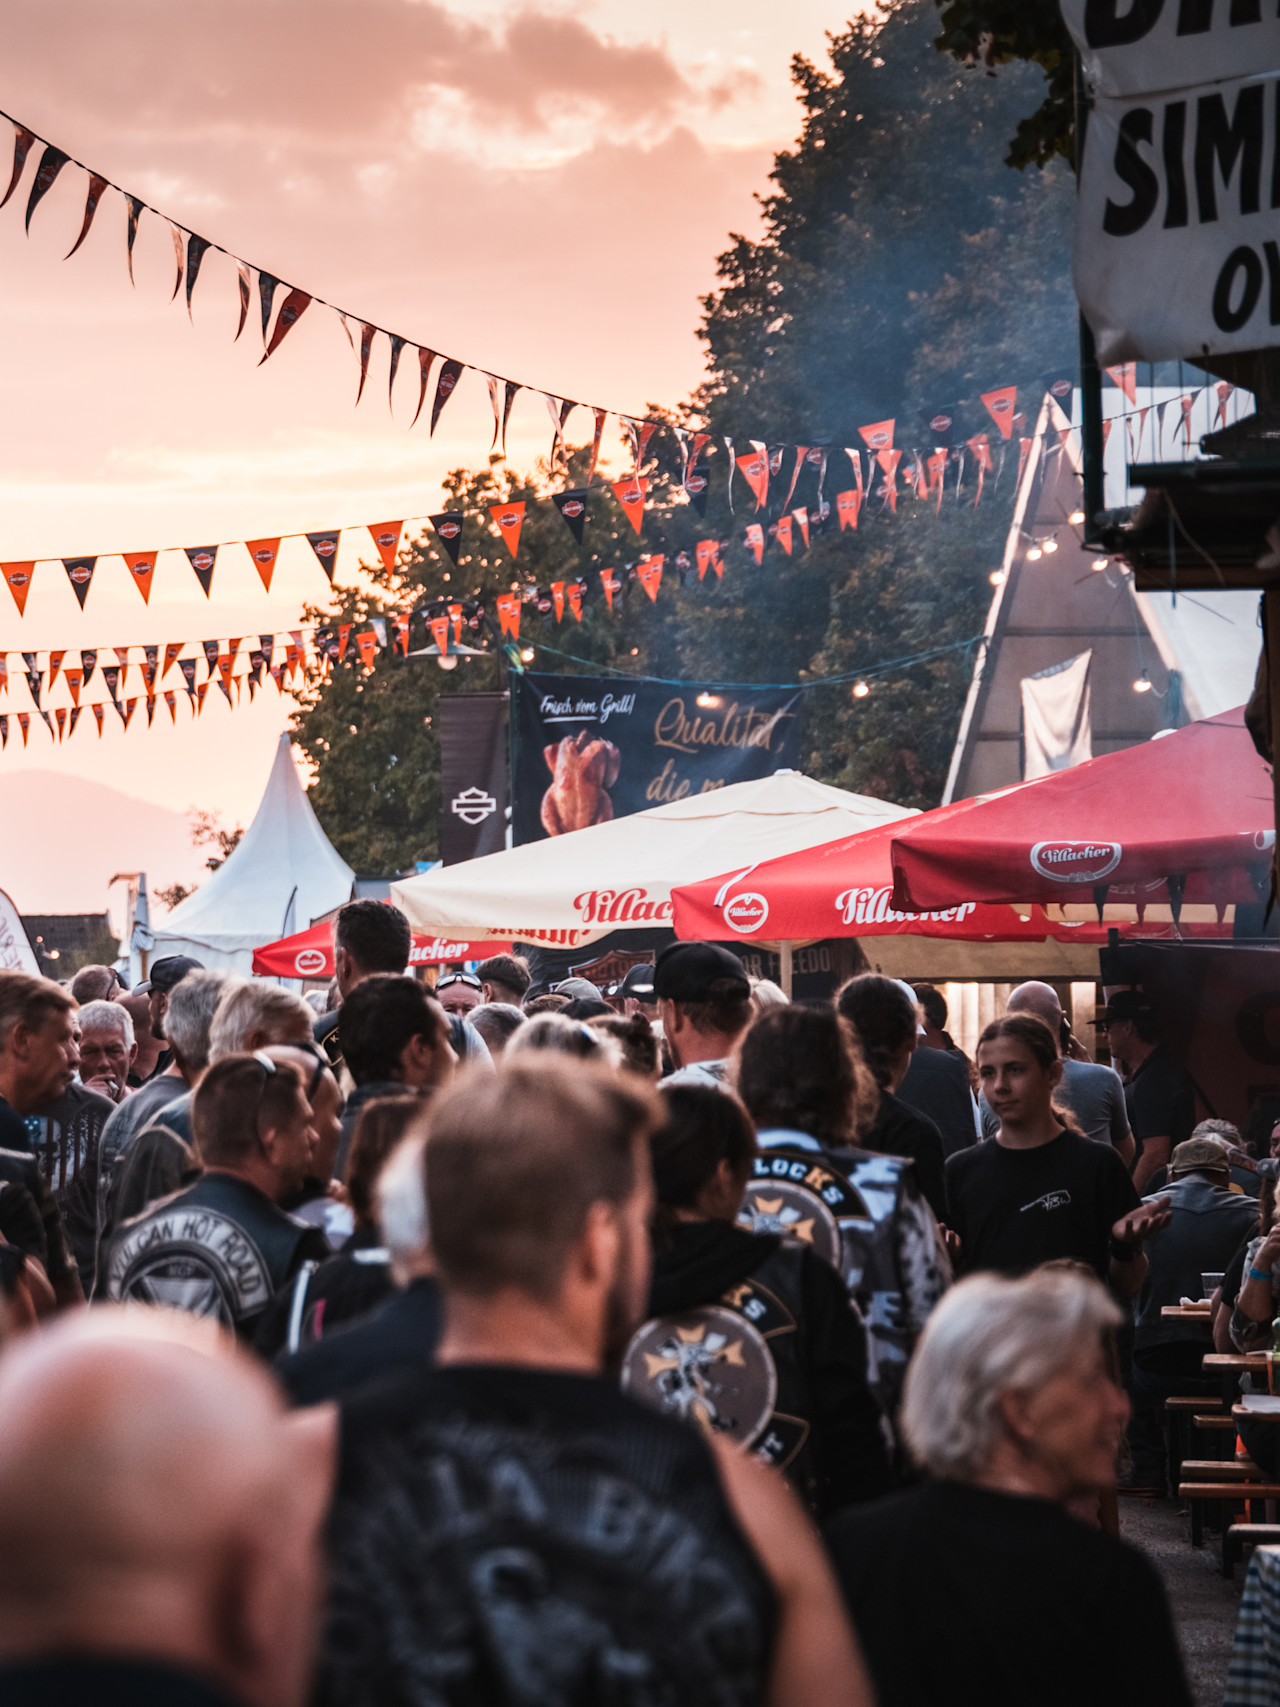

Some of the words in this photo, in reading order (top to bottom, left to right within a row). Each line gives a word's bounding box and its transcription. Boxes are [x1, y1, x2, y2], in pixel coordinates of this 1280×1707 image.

[1102, 80, 1280, 237] SIM
[540, 695, 573, 716] Frisch
[1042, 846, 1110, 864] Villacher
[573, 888, 675, 924] Villac
